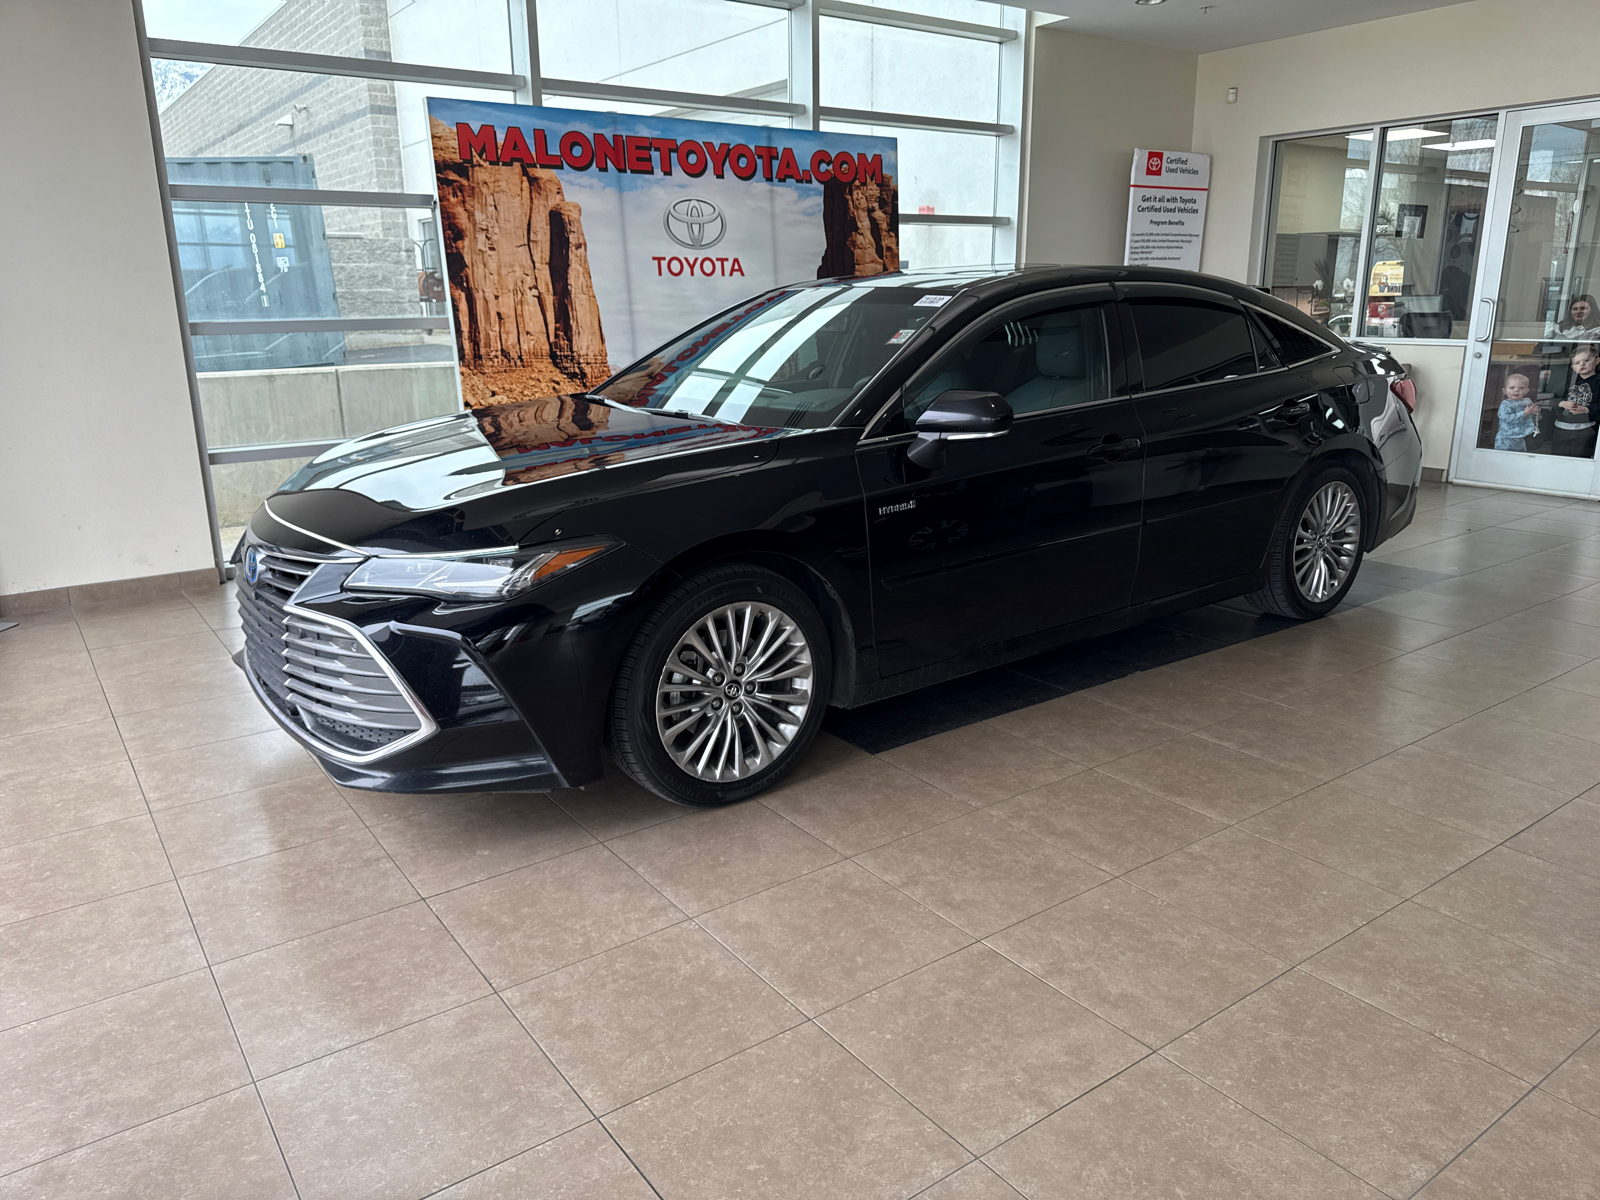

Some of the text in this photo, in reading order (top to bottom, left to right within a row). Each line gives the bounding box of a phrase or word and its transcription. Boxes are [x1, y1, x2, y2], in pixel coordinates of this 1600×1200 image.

[456, 122, 884, 185] MALONETOYOTA.COM
[1166, 157, 1188, 165] Certified
[1179, 167, 1199, 175] Vehicles
[1179, 197, 1196, 205] Toyota
[1137, 205, 1161, 213] Certified
[652, 256, 746, 277] TOYOTA
[878, 500, 916, 515] HYBRID
